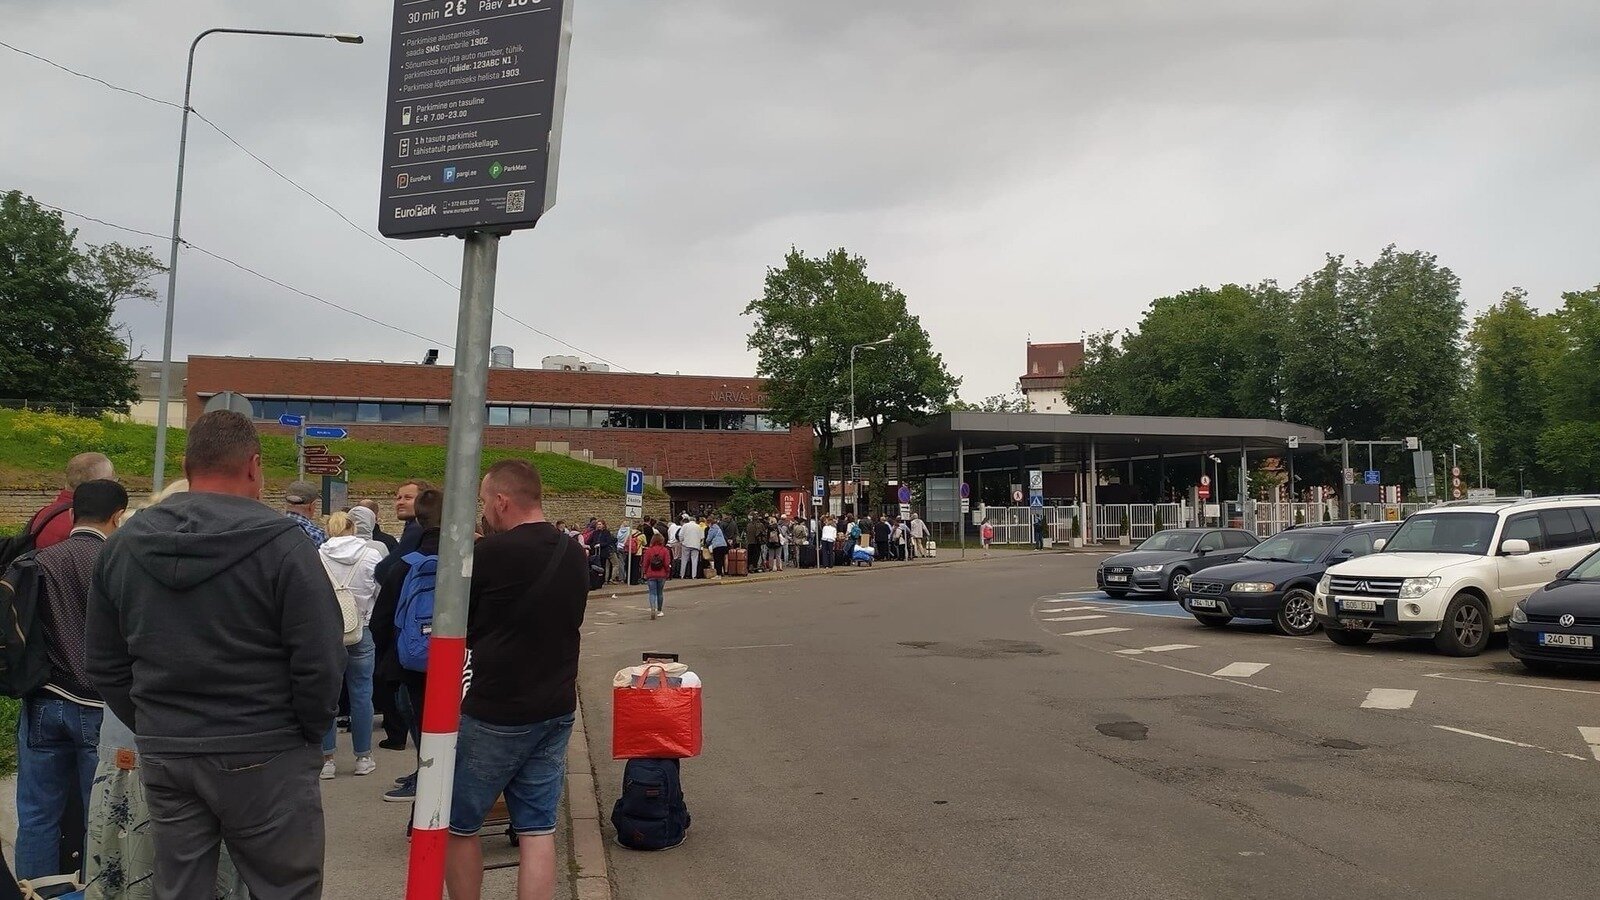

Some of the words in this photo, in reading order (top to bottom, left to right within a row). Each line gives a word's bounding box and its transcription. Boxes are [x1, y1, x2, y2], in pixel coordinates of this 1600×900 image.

[408, 11, 420, 24] 30
[422, 9, 440, 21] min
[406, 36, 437, 46] Parkimise
[438, 28, 480, 42] alustamiseks
[406, 48, 424, 58] saada
[425, 44, 440, 54] SMS
[405, 58, 438, 70] Sõnumisse
[440, 54, 460, 64] kirjuta
[461, 52, 476, 60] auto
[404, 67, 448, 81] parkimistsoon
[472, 58, 500, 70] 123ABC
[502, 56, 512, 64] N1
[403, 82, 433, 92] Parkimise
[434, 75, 476, 89] lõpetamiseks
[478, 72, 500, 81] helista
[416, 102, 448, 112] Parkimine
[458, 97, 485, 106] tasuline
[416, 114, 428, 124] E-R
[430, 110, 468, 122] 7.00-23.00
[426, 134, 446, 143] tasuta
[446, 130, 478, 142] parkimist
[413, 144, 446, 156] tähistatult
[446, 170, 453, 180] P
[456, 170, 477, 178] pargi.ee
[492, 166, 499, 174] P
[504, 164, 526, 172] ParkMan
[410, 174, 432, 183] EuroPark
[394, 204, 437, 218] EuroPark
[630, 472, 640, 492] P
[1548, 634, 1564, 644] 240
[1570, 636, 1588, 646] BTT
